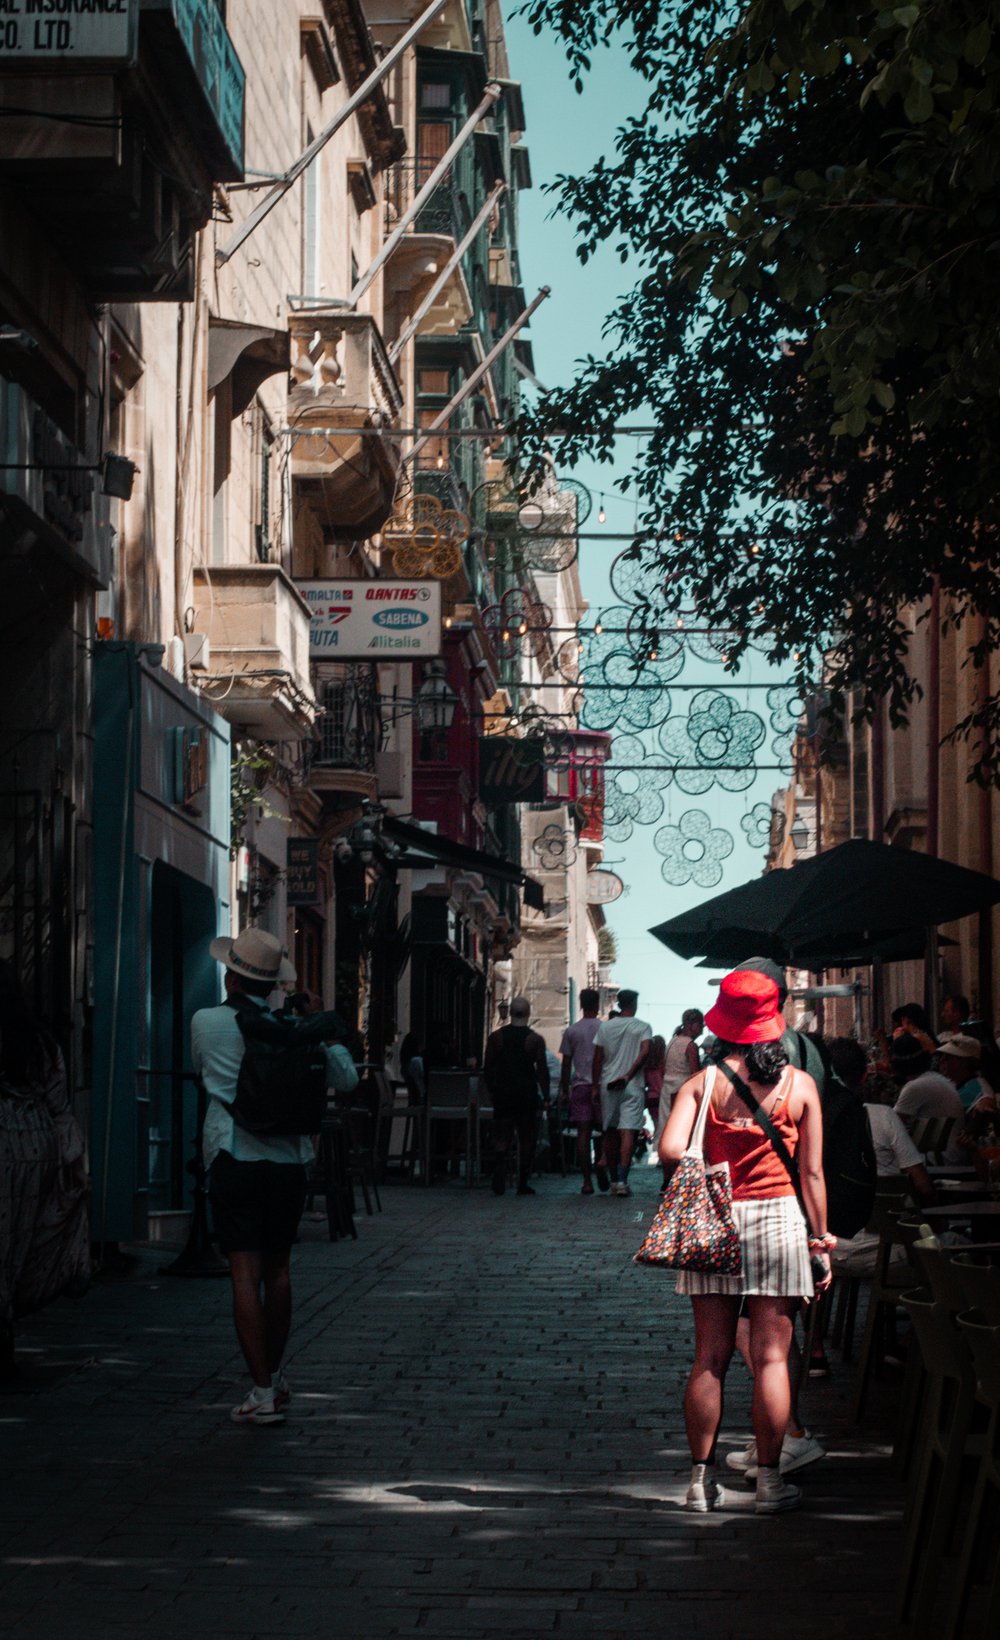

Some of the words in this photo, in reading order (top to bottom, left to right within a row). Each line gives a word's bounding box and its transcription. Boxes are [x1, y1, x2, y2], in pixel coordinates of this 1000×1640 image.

[34, 19, 74, 49] LTD.
[365, 588, 418, 601] QANTAS
[378, 612, 423, 626] SABENA
[367, 635, 421, 649] Alitalia
